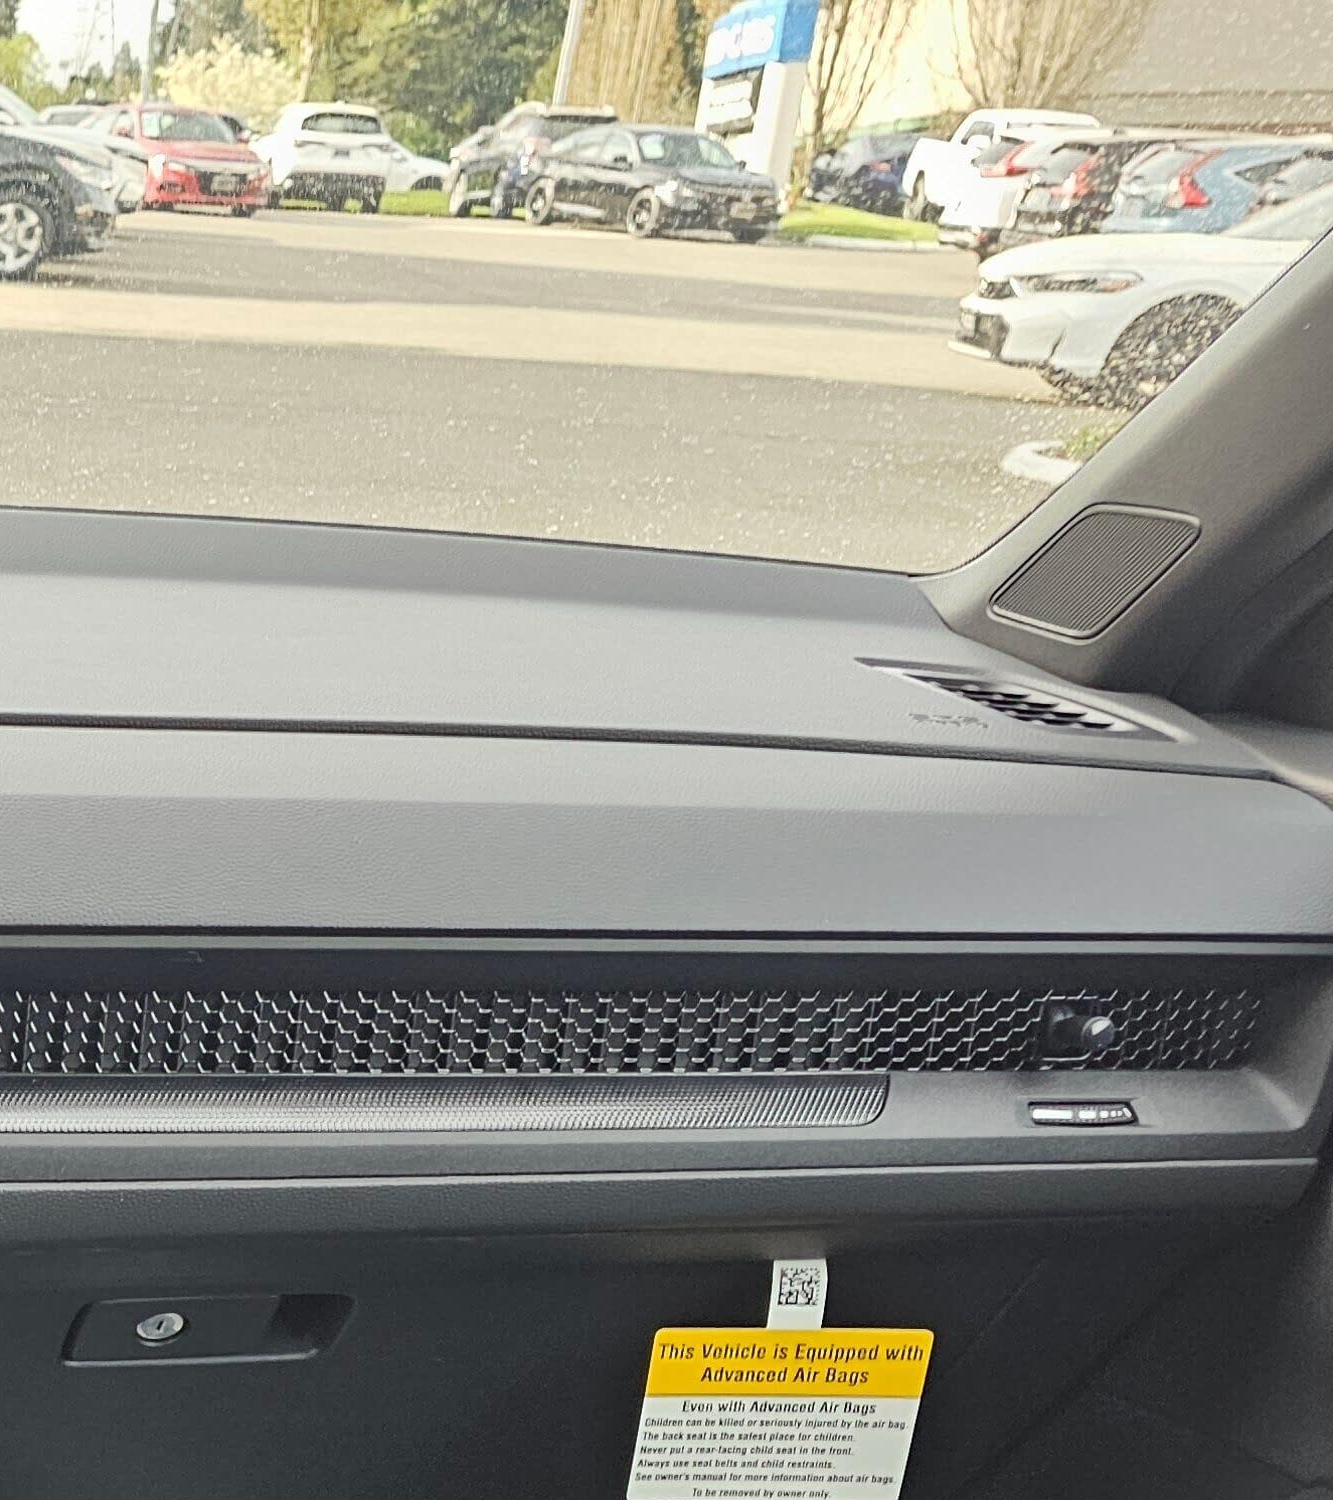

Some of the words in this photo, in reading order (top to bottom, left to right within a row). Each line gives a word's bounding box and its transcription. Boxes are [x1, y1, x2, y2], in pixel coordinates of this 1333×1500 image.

[659, 1343, 695, 1360] This
[702, 1343, 767, 1360] Vehicle
[772, 1343, 789, 1360] is
[794, 1343, 880, 1363] Equipped
[886, 1344, 924, 1361] with
[700, 1366, 788, 1383] Advanced
[792, 1366, 820, 1383] Air
[825, 1367, 870, 1388] Bags
[681, 1400, 713, 1413] Even
[718, 1400, 745, 1413] with
[750, 1401, 816, 1414] Advanced
[819, 1401, 840, 1414] Air
[843, 1402, 877, 1416] Bags
[644, 1417, 683, 1427] Children
[685, 1419, 702, 1427] can
[704, 1418, 716, 1427] be
[718, 1418, 745, 1428] killed
[747, 1419, 758, 1428] or
[759, 1419, 802, 1429] seriously
[804, 1419, 839, 1430] injured
[840, 1419, 852, 1430] by
[854, 1419, 870, 1429] the
[872, 1420, 885, 1429] air
[642, 1431, 660, 1441] The
[662, 1431, 684, 1441] back
[686, 1432, 707, 1441] seat
[709, 1432, 718, 1441] is
[720, 1432, 735, 1441] the
[737, 1432, 767, 1442] safest
[769, 1433, 795, 1443] place
[798, 1433, 812, 1442] for
[640, 1445, 668, 1455] Never
[669, 1446, 685, 1457] put
[687, 1447, 693, 1455] a
[695, 1446, 747, 1456] rear-facing
[749, 1446, 774, 1455] child
[776, 1446, 797, 1455] seat
[799, 1446, 809, 1455] in
[811, 1446, 826, 1456] the
[636, 1459, 671, 1470] Always
[673, 1460, 690, 1469] use
[692, 1460, 713, 1469] seat
[715, 1459, 738, 1469] belts
[740, 1460, 759, 1469] and
[761, 1460, 785, 1469] child
[634, 1472, 653, 1482] See
[654, 1472, 690, 1482] owner's
[692, 1472, 727, 1482] manual
[729, 1473, 742, 1482] for
[744, 1474, 769, 1482] more
[771, 1473, 825, 1483] information
[827, 1474, 854, 1483] about
[855, 1474, 869, 1484] air
[692, 1487, 703, 1497] To
[704, 1488, 717, 1497] be
[719, 1488, 761, 1498] removed
[763, 1488, 775, 1499] by
[777, 1490, 807, 1498] owner
